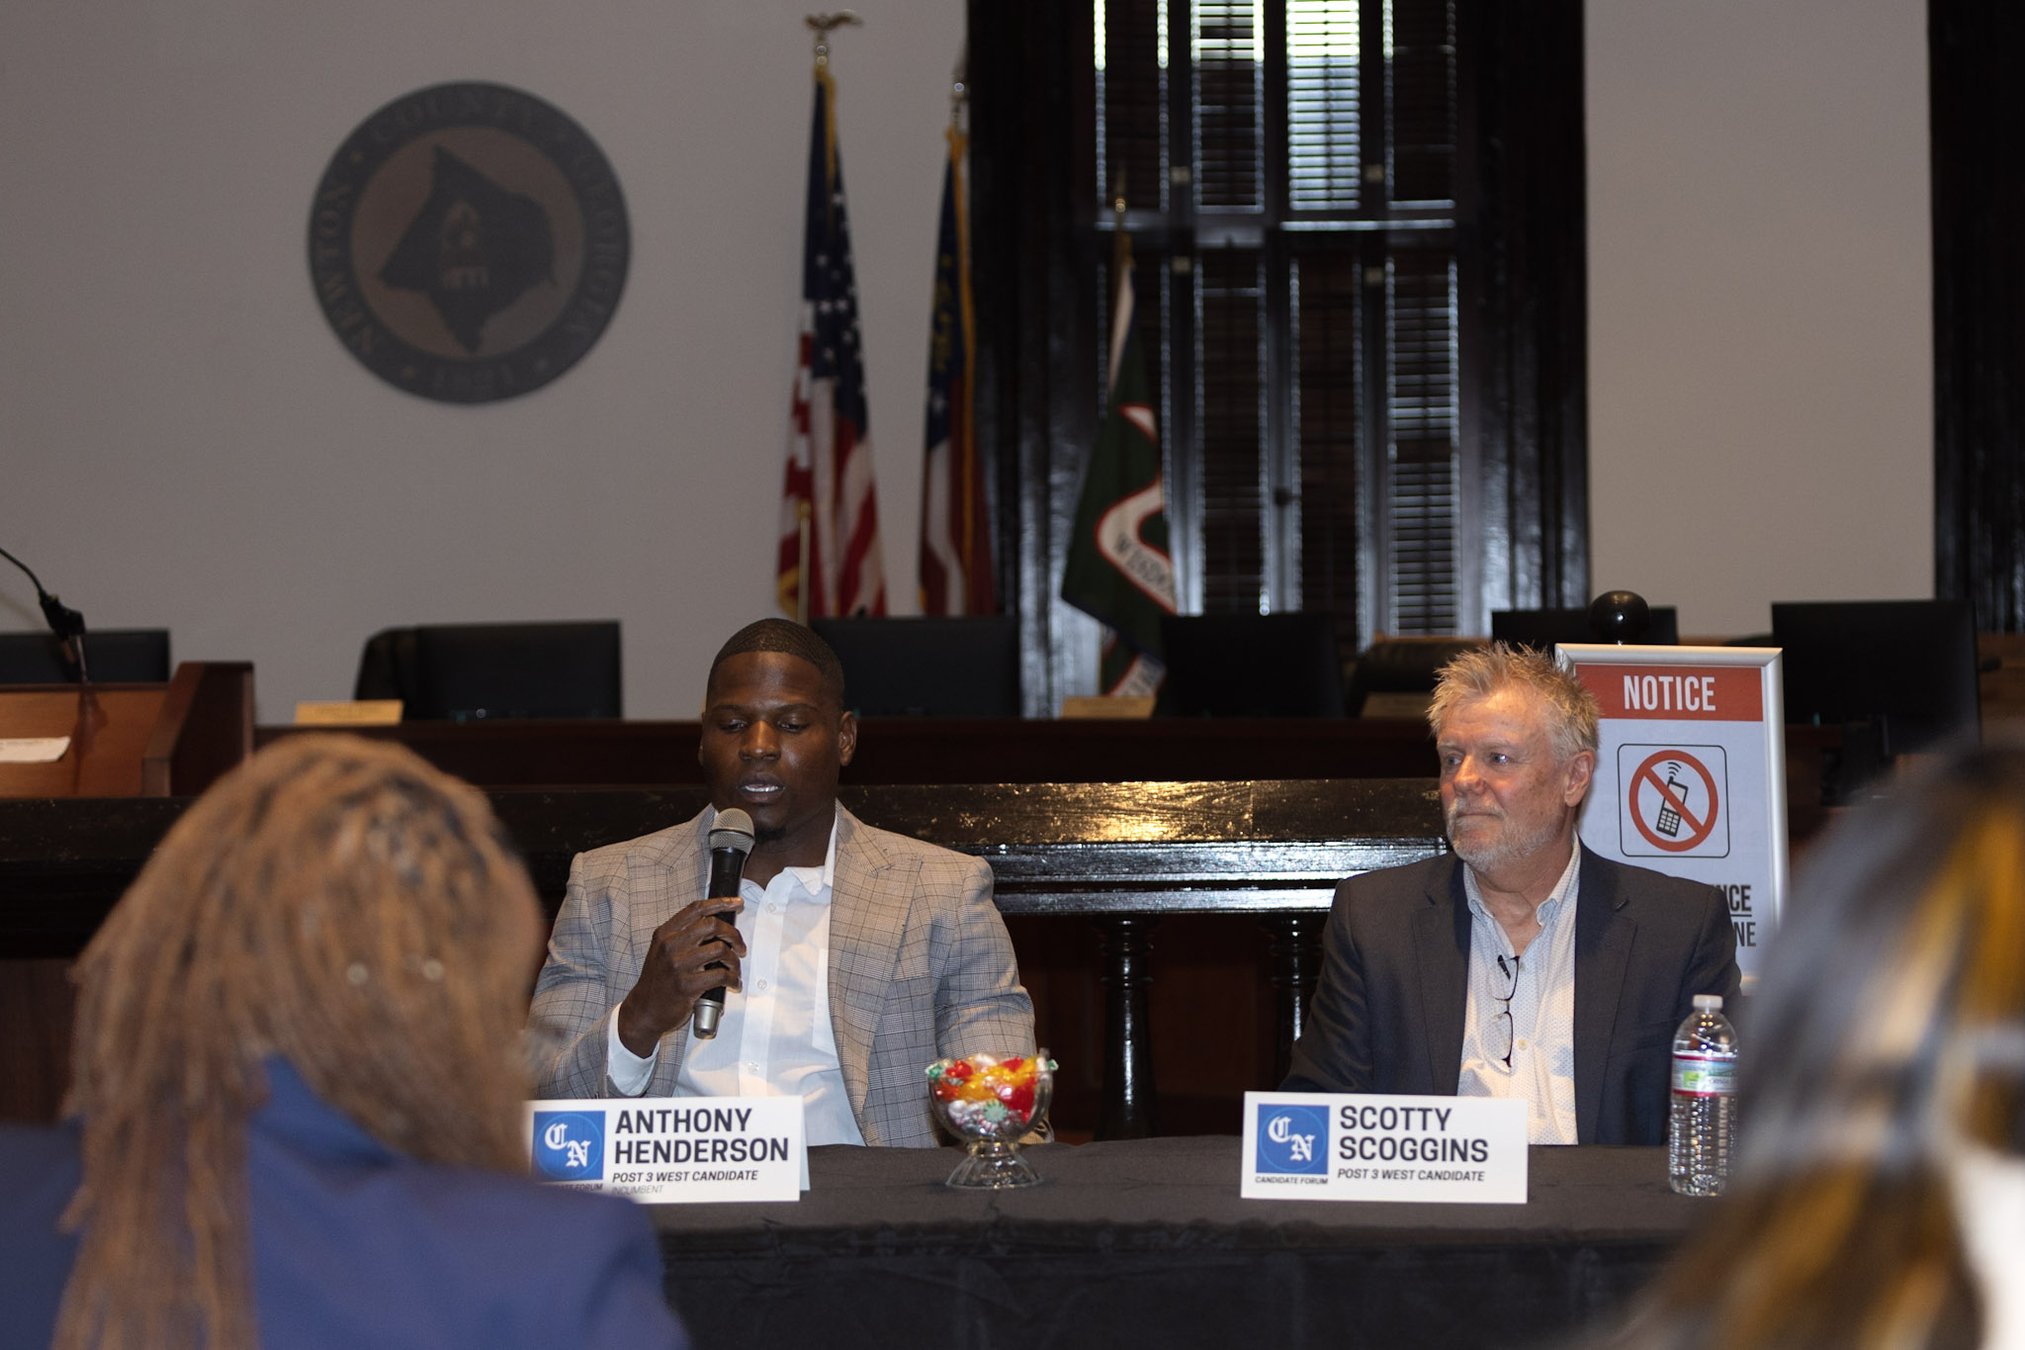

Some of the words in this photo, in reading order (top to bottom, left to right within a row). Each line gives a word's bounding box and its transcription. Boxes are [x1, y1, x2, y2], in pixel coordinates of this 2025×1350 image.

[1623, 674, 1716, 712] NOTICE
[1716, 884, 1752, 912] CE
[614, 1107, 752, 1134] ANTHONY
[1339, 1105, 1453, 1132] SCOTTY
[614, 1137, 789, 1164] HENDERSON
[1339, 1136, 1489, 1164] SCOGGINS
[612, 1172, 644, 1183] POST
[646, 1172, 654, 1182] 3
[656, 1171, 690, 1183] WEST
[692, 1170, 759, 1182] CANDIDATE
[1255, 1176, 1299, 1185] CANDIDATE
[1300, 1177, 1328, 1185] FORUM
[1337, 1168, 1370, 1180] POST
[1371, 1169, 1379, 1180] 3
[1381, 1169, 1416, 1181] WEST
[1418, 1170, 1486, 1182] CANDIDATE
